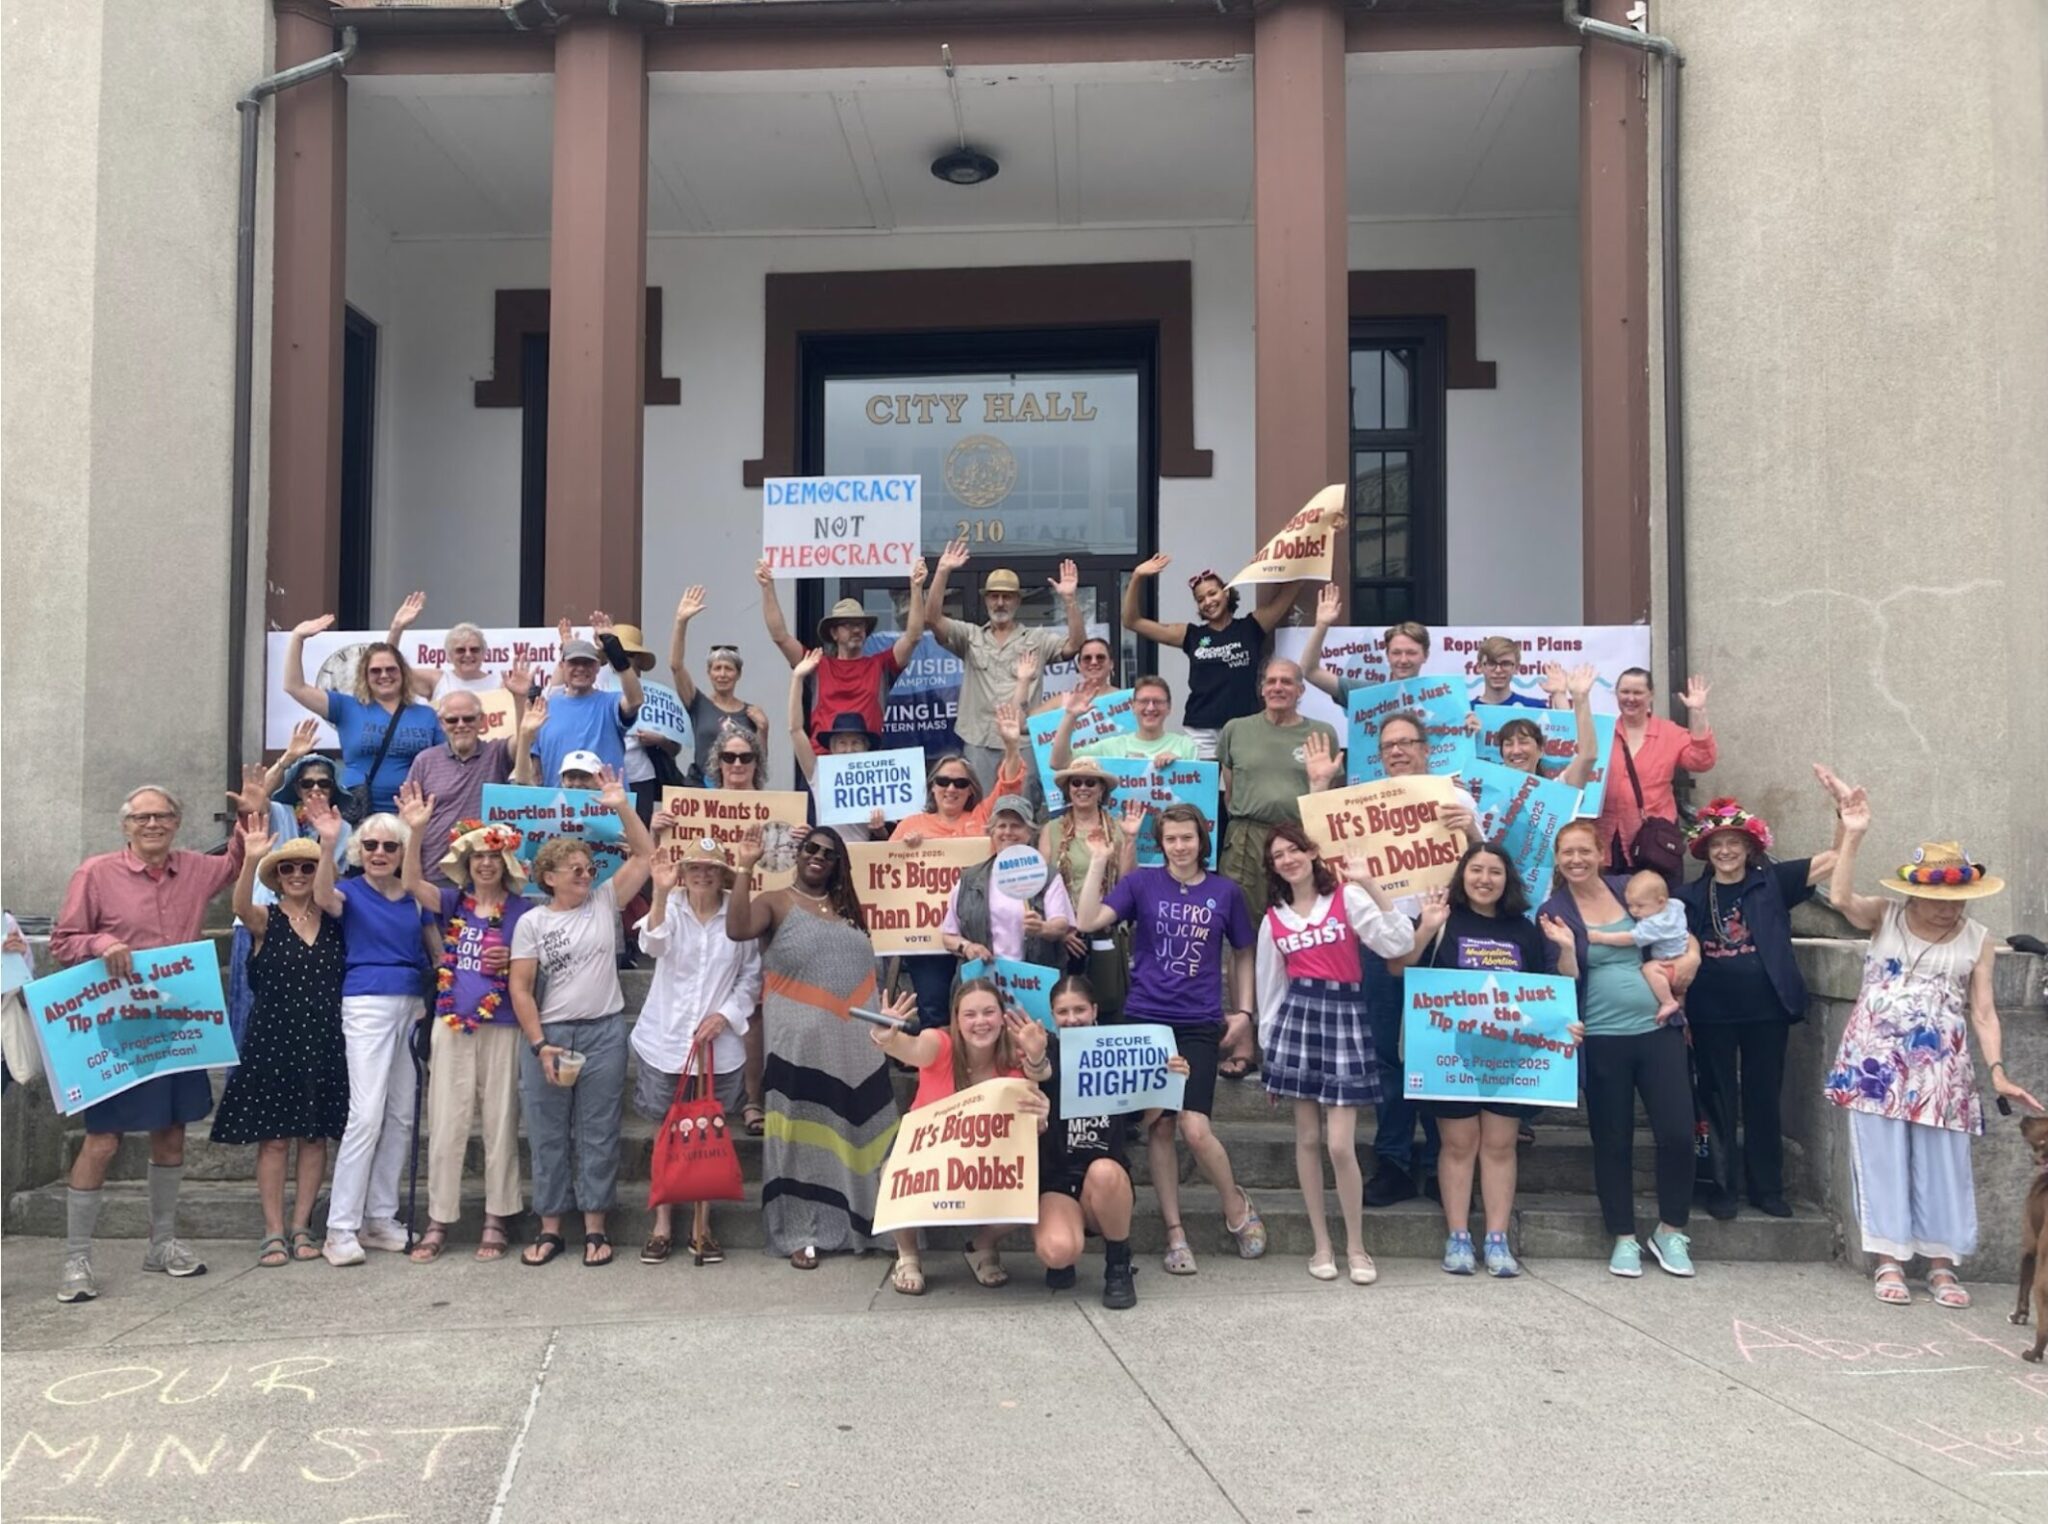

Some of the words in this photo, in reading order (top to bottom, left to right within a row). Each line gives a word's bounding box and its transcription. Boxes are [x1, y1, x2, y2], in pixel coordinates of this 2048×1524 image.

[865, 394, 968, 424] CITY
[984, 392, 1097, 422] HALL
[767, 480, 917, 505] DEMOCRACY
[814, 515, 864, 538] NOT
[1283, 507, 1325, 532] gger
[956, 520, 1005, 543] 210
[765, 542, 915, 568] THEOCRACY
[1273, 534, 1327, 561] Dobbs!
[417, 643, 510, 668] Repans
[513, 641, 556, 663] Want
[1537, 636, 1583, 651] Plans
[1363, 653, 1383, 664] the
[1347, 667, 1363, 680] of
[1364, 669, 1387, 682] the
[643, 692, 683, 716] ORTION
[1354, 698, 1400, 724] Abortion
[1418, 683, 1452, 701] Just
[641, 705, 685, 733] GHTS
[882, 722, 916, 734] TERN
[918, 720, 948, 732] MASS
[1095, 723, 1116, 735] the
[848, 758, 896, 770] SECURE
[834, 765, 911, 787] ABORTION
[1169, 770, 1201, 785] Just
[834, 782, 912, 809] RIGHTS
[1151, 789, 1172, 802] the
[489, 804, 556, 821] Abortion
[671, 797, 700, 818] GOP
[704, 799, 751, 820] Wants
[755, 802, 770, 820] to
[560, 820, 584, 832] the
[1326, 811, 1365, 842] It's
[1366, 801, 1440, 836] Bigger
[999, 855, 1040, 870] ABORTION
[1385, 834, 1462, 875] Dobbs!
[869, 862, 902, 890] It's
[906, 860, 967, 894] Bigge
[1380, 879, 1410, 891] VOTE!
[1158, 901, 1212, 924] REPRO
[904, 935, 932, 944] VOTE!
[1156, 920, 1210, 940] DUCTIVE
[1276, 923, 1347, 954] RESIST
[1155, 938, 1205, 963] JUS
[44, 976, 122, 1024] Abortion
[148, 956, 195, 982] Just
[1011, 974, 1041, 991] Just
[130, 988, 159, 1001] the
[1412, 989, 1489, 1010] Abortion
[1514, 985, 1557, 1002] Just
[66, 1013, 92, 1033] Tip
[97, 1007, 116, 1025] of
[119, 1004, 151, 1020] the
[156, 1006, 224, 1025] Iceberg
[1493, 1007, 1522, 1022] the
[1096, 1035, 1152, 1047] SECURE
[1429, 1010, 1454, 1033] Tip
[1457, 1018, 1478, 1034] of
[1480, 1021, 1509, 1042] the
[1512, 1027, 1577, 1060] Iceberg
[87, 1049, 119, 1069] GOP's
[121, 1034, 168, 1055] Project
[171, 1028, 203, 1041] 2025
[1079, 1046, 1169, 1069] ABORTION
[101, 1068, 112, 1081] is
[114, 1044, 198, 1076] Un-American!
[1436, 1055, 1470, 1068] GOP's
[1472, 1056, 1516, 1070] Project
[1518, 1059, 1551, 1071] 2025
[1078, 1067, 1169, 1097] RIGHTS
[1446, 1072, 1457, 1083] is
[1459, 1072, 1541, 1088] Un-American!
[908, 1123, 940, 1154] It's
[940, 1110, 1015, 1147] Bigger
[890, 1166, 940, 1200] Than
[946, 1156, 1025, 1191] Dobbs!
[932, 1200, 966, 1210] VOTE!
[44, 1356, 335, 1405] OUR
